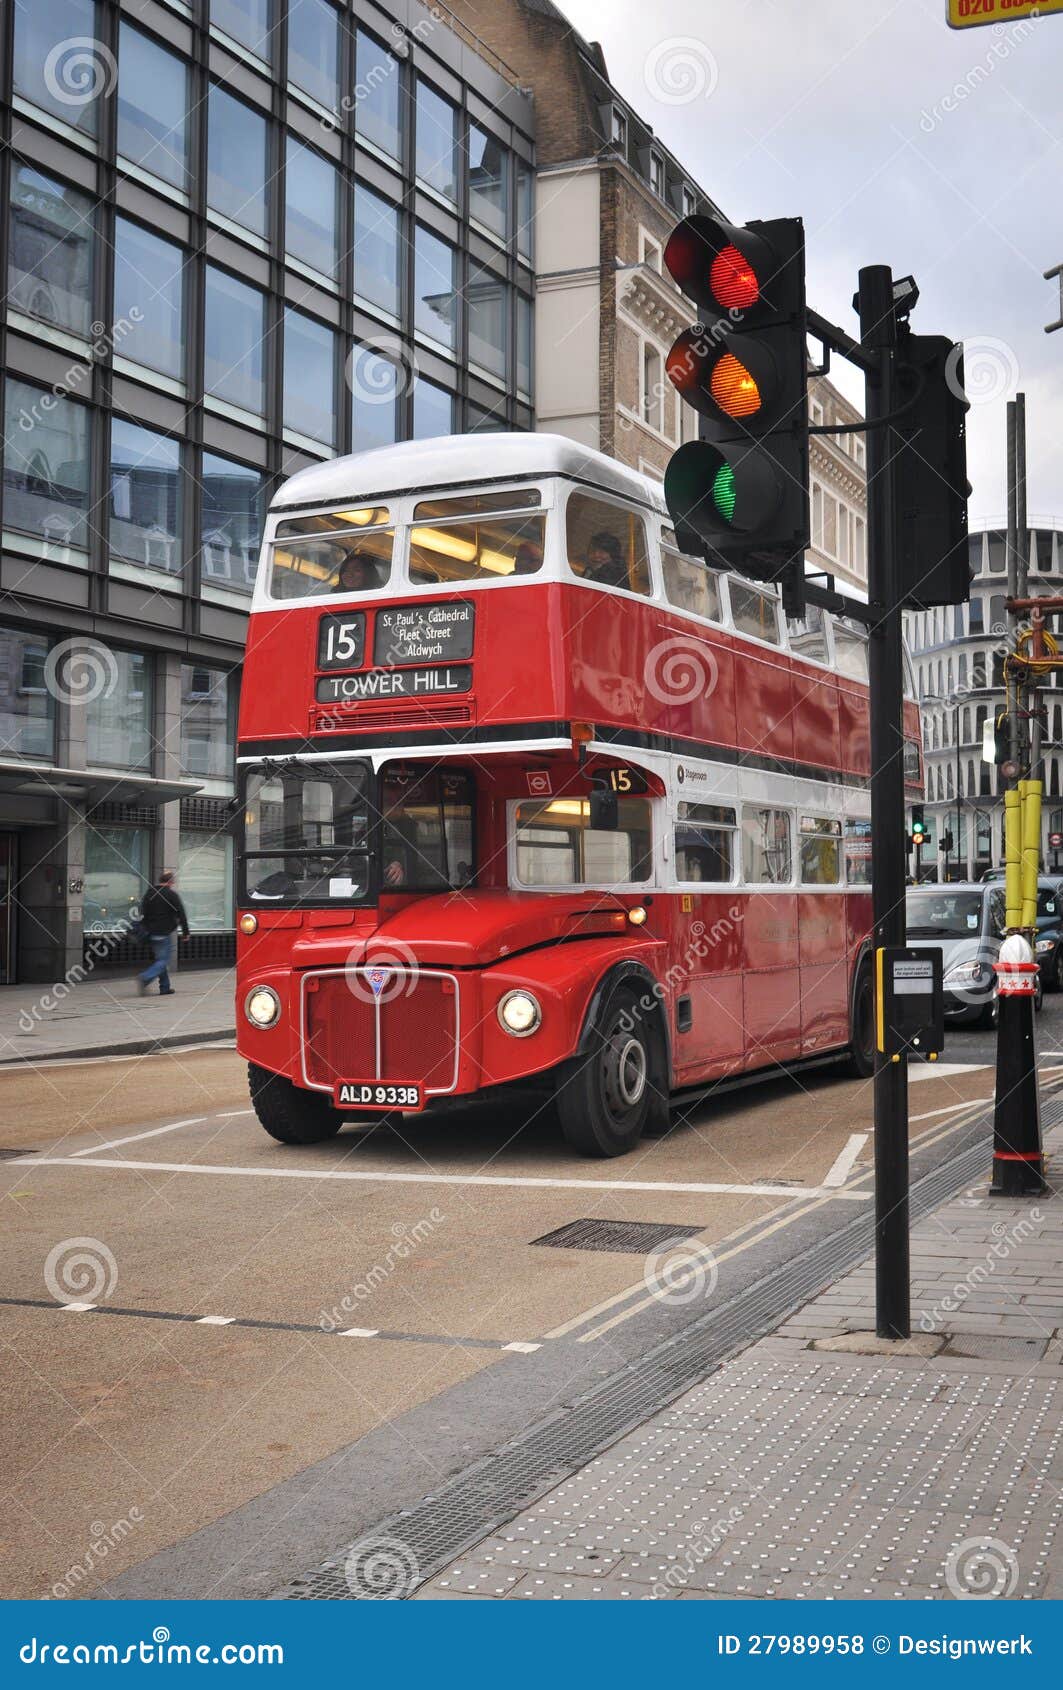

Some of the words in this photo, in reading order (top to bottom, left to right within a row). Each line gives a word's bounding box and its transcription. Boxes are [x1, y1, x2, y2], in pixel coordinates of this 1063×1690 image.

[383, 614, 392, 627] St
[397, 612, 424, 626] Paul's
[428, 608, 469, 623] Cathedral
[327, 623, 357, 661] 15
[399, 629, 420, 641] Fleet
[425, 627, 451, 639] Street
[407, 643, 442, 659] Aldwych
[330, 674, 405, 697] TOWER
[414, 670, 458, 691] HILL
[610, 769, 632, 792] 15
[340, 1086, 372, 1103] ALD
[375, 1087, 418, 1104] 933B
